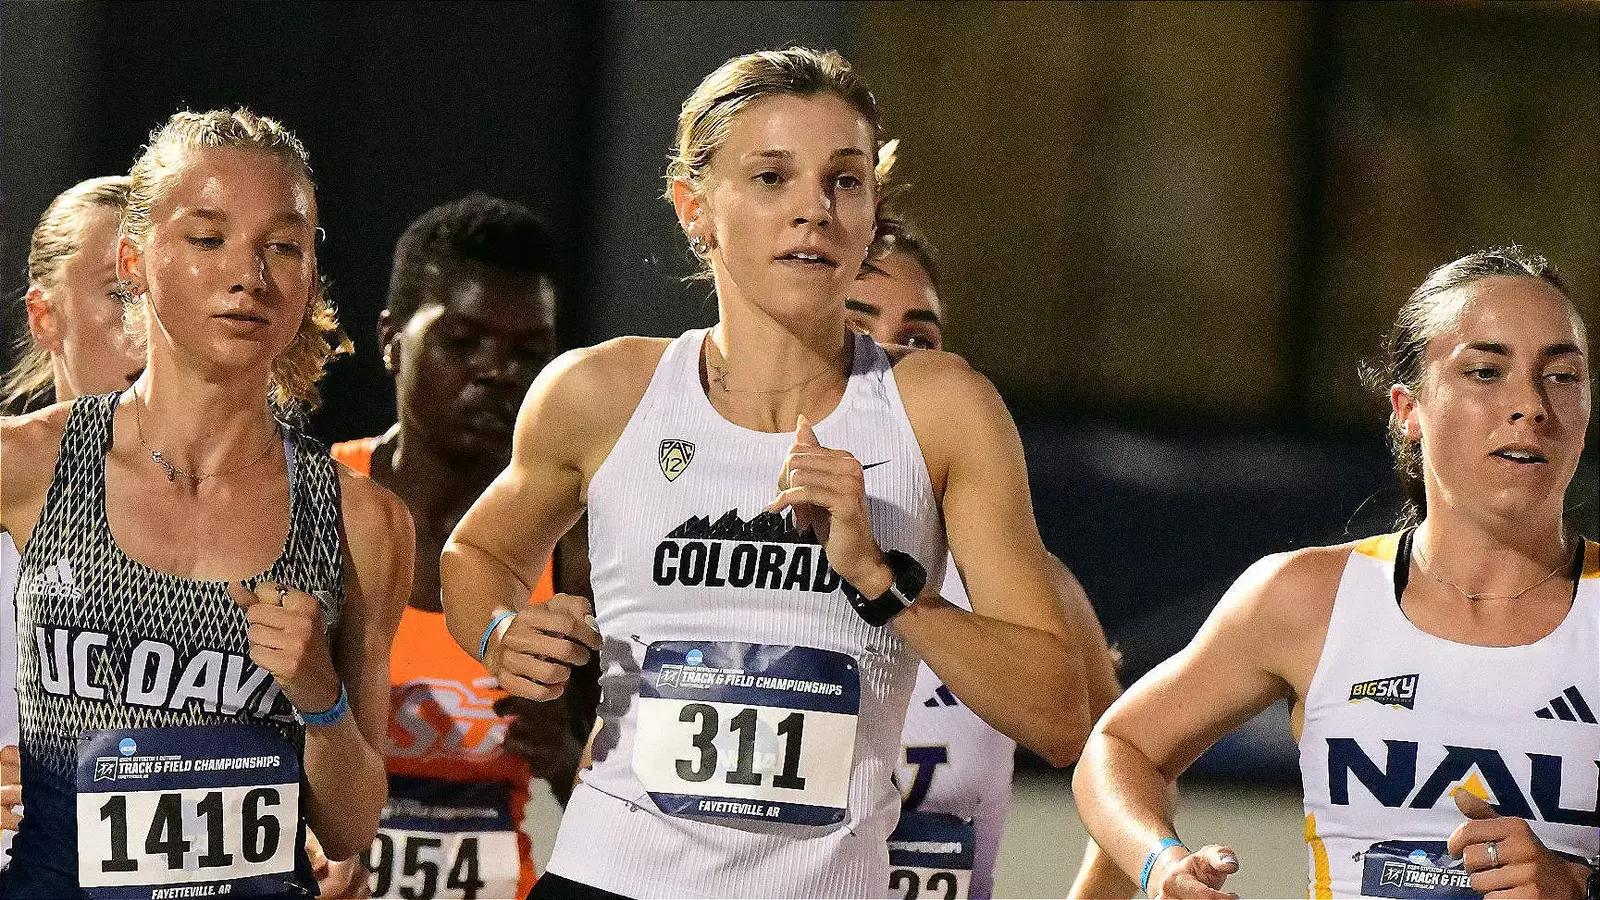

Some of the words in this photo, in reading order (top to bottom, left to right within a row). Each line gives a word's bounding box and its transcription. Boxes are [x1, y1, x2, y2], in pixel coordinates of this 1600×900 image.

[661, 441, 693, 463] PAC
[665, 457, 683, 472] 12
[653, 541, 842, 594] COLORAD
[29, 581, 82, 602] adidas
[36, 626, 109, 699] UC
[126, 639, 292, 721] DAVI
[682, 671, 716, 685] TRACK
[716, 674, 725, 685] &
[725, 674, 754, 688] FIELD
[756, 676, 842, 696] CHAMPIONSHIPS
[675, 703, 806, 790] 311
[119, 761, 153, 774] TRACK
[154, 761, 162, 773] &
[163, 759, 192, 773] FIELD
[194, 755, 280, 771] CHAMPIONSHIPS
[1325, 737, 1600, 828] NAU
[699, 800, 764, 816] FAYETTEVILLE,
[765, 806, 780, 817] AR
[100, 787, 281, 873] 1416
[360, 834, 485, 900] 954
[1405, 871, 1438, 884] TRACK
[1440, 874, 1449, 885] &
[1450, 876, 1472, 888] FIEL
[151, 886, 215, 900] FAYETTEVILLE,
[218, 884, 232, 894] AR
